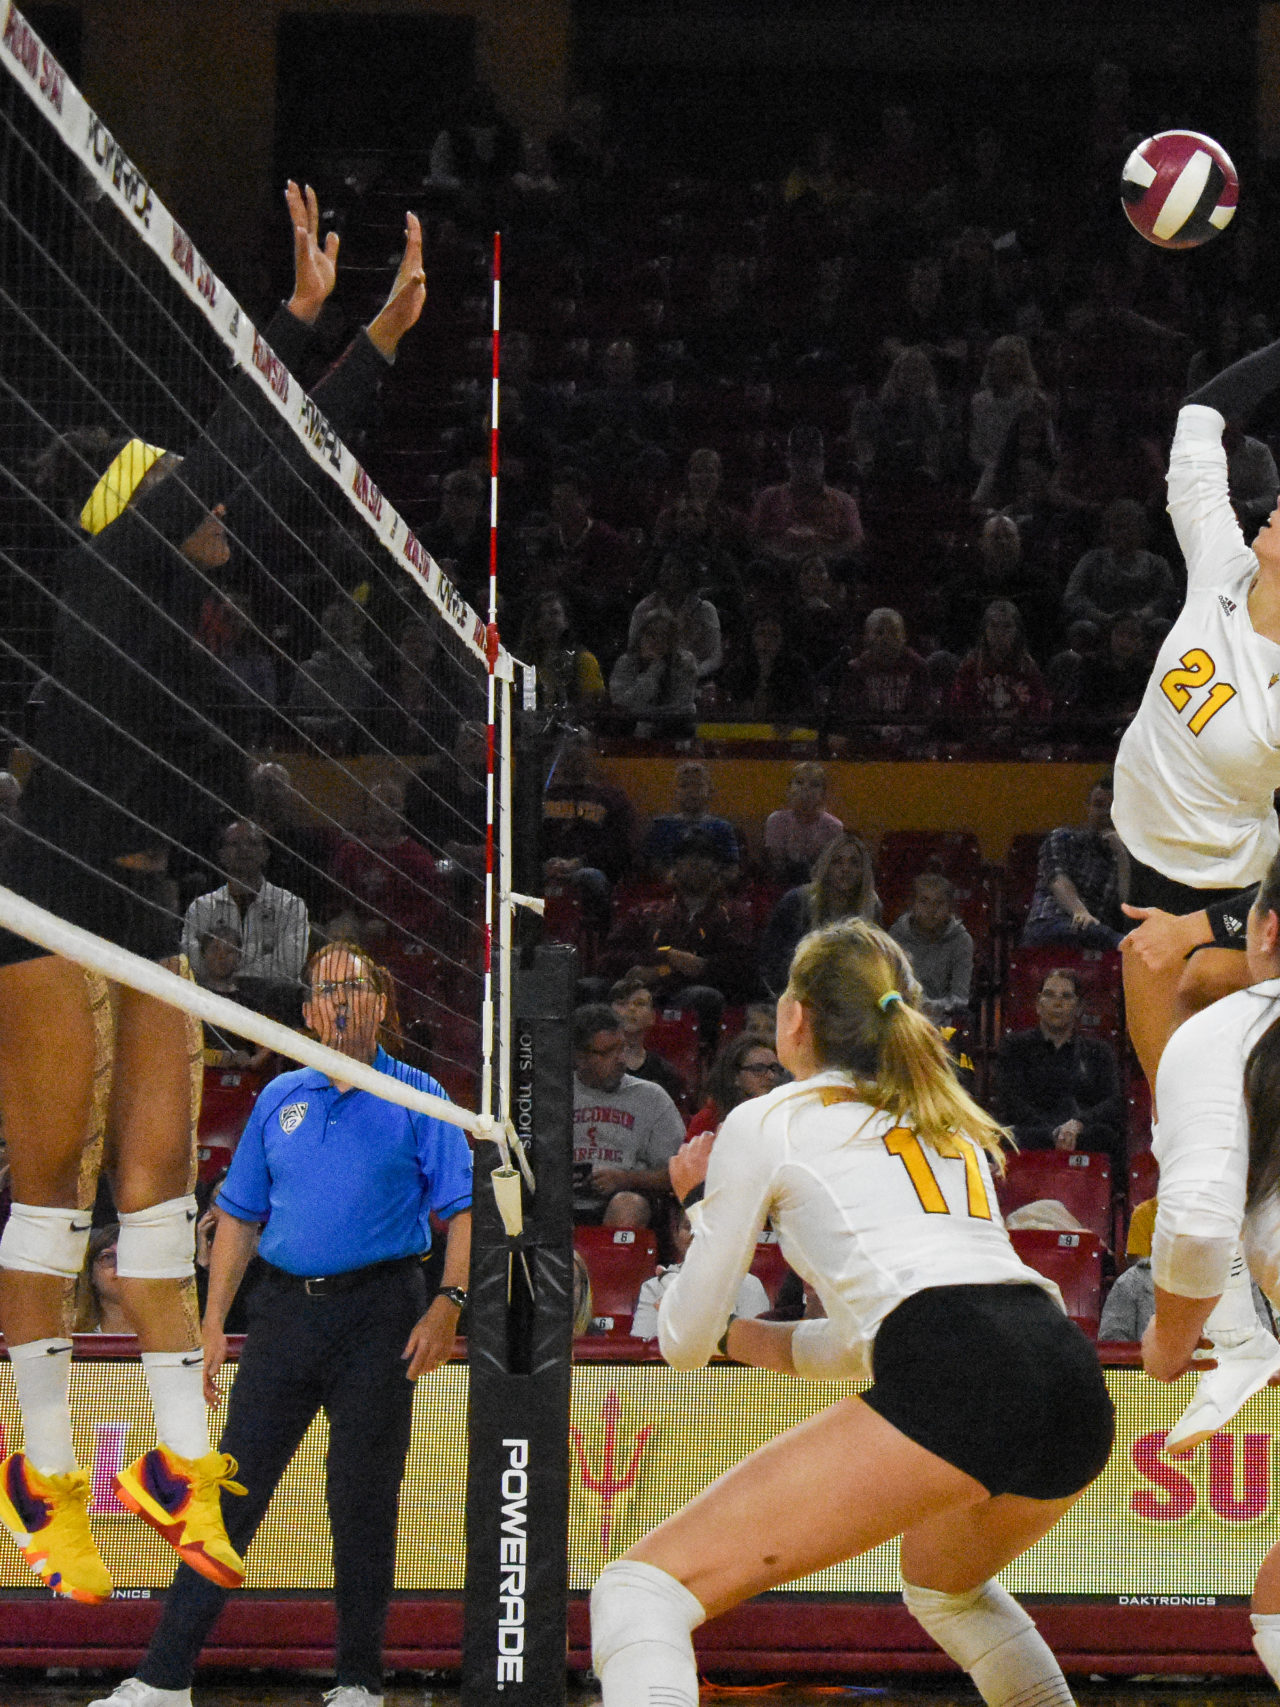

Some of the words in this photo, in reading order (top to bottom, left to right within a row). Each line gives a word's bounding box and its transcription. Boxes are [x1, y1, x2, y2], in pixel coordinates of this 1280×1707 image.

[1160, 648, 1238, 737] 21
[882, 1126, 993, 1221] 17
[496, 1439, 529, 1684] POWERADE
[1118, 1595, 1217, 1606] DAKTRONICS
